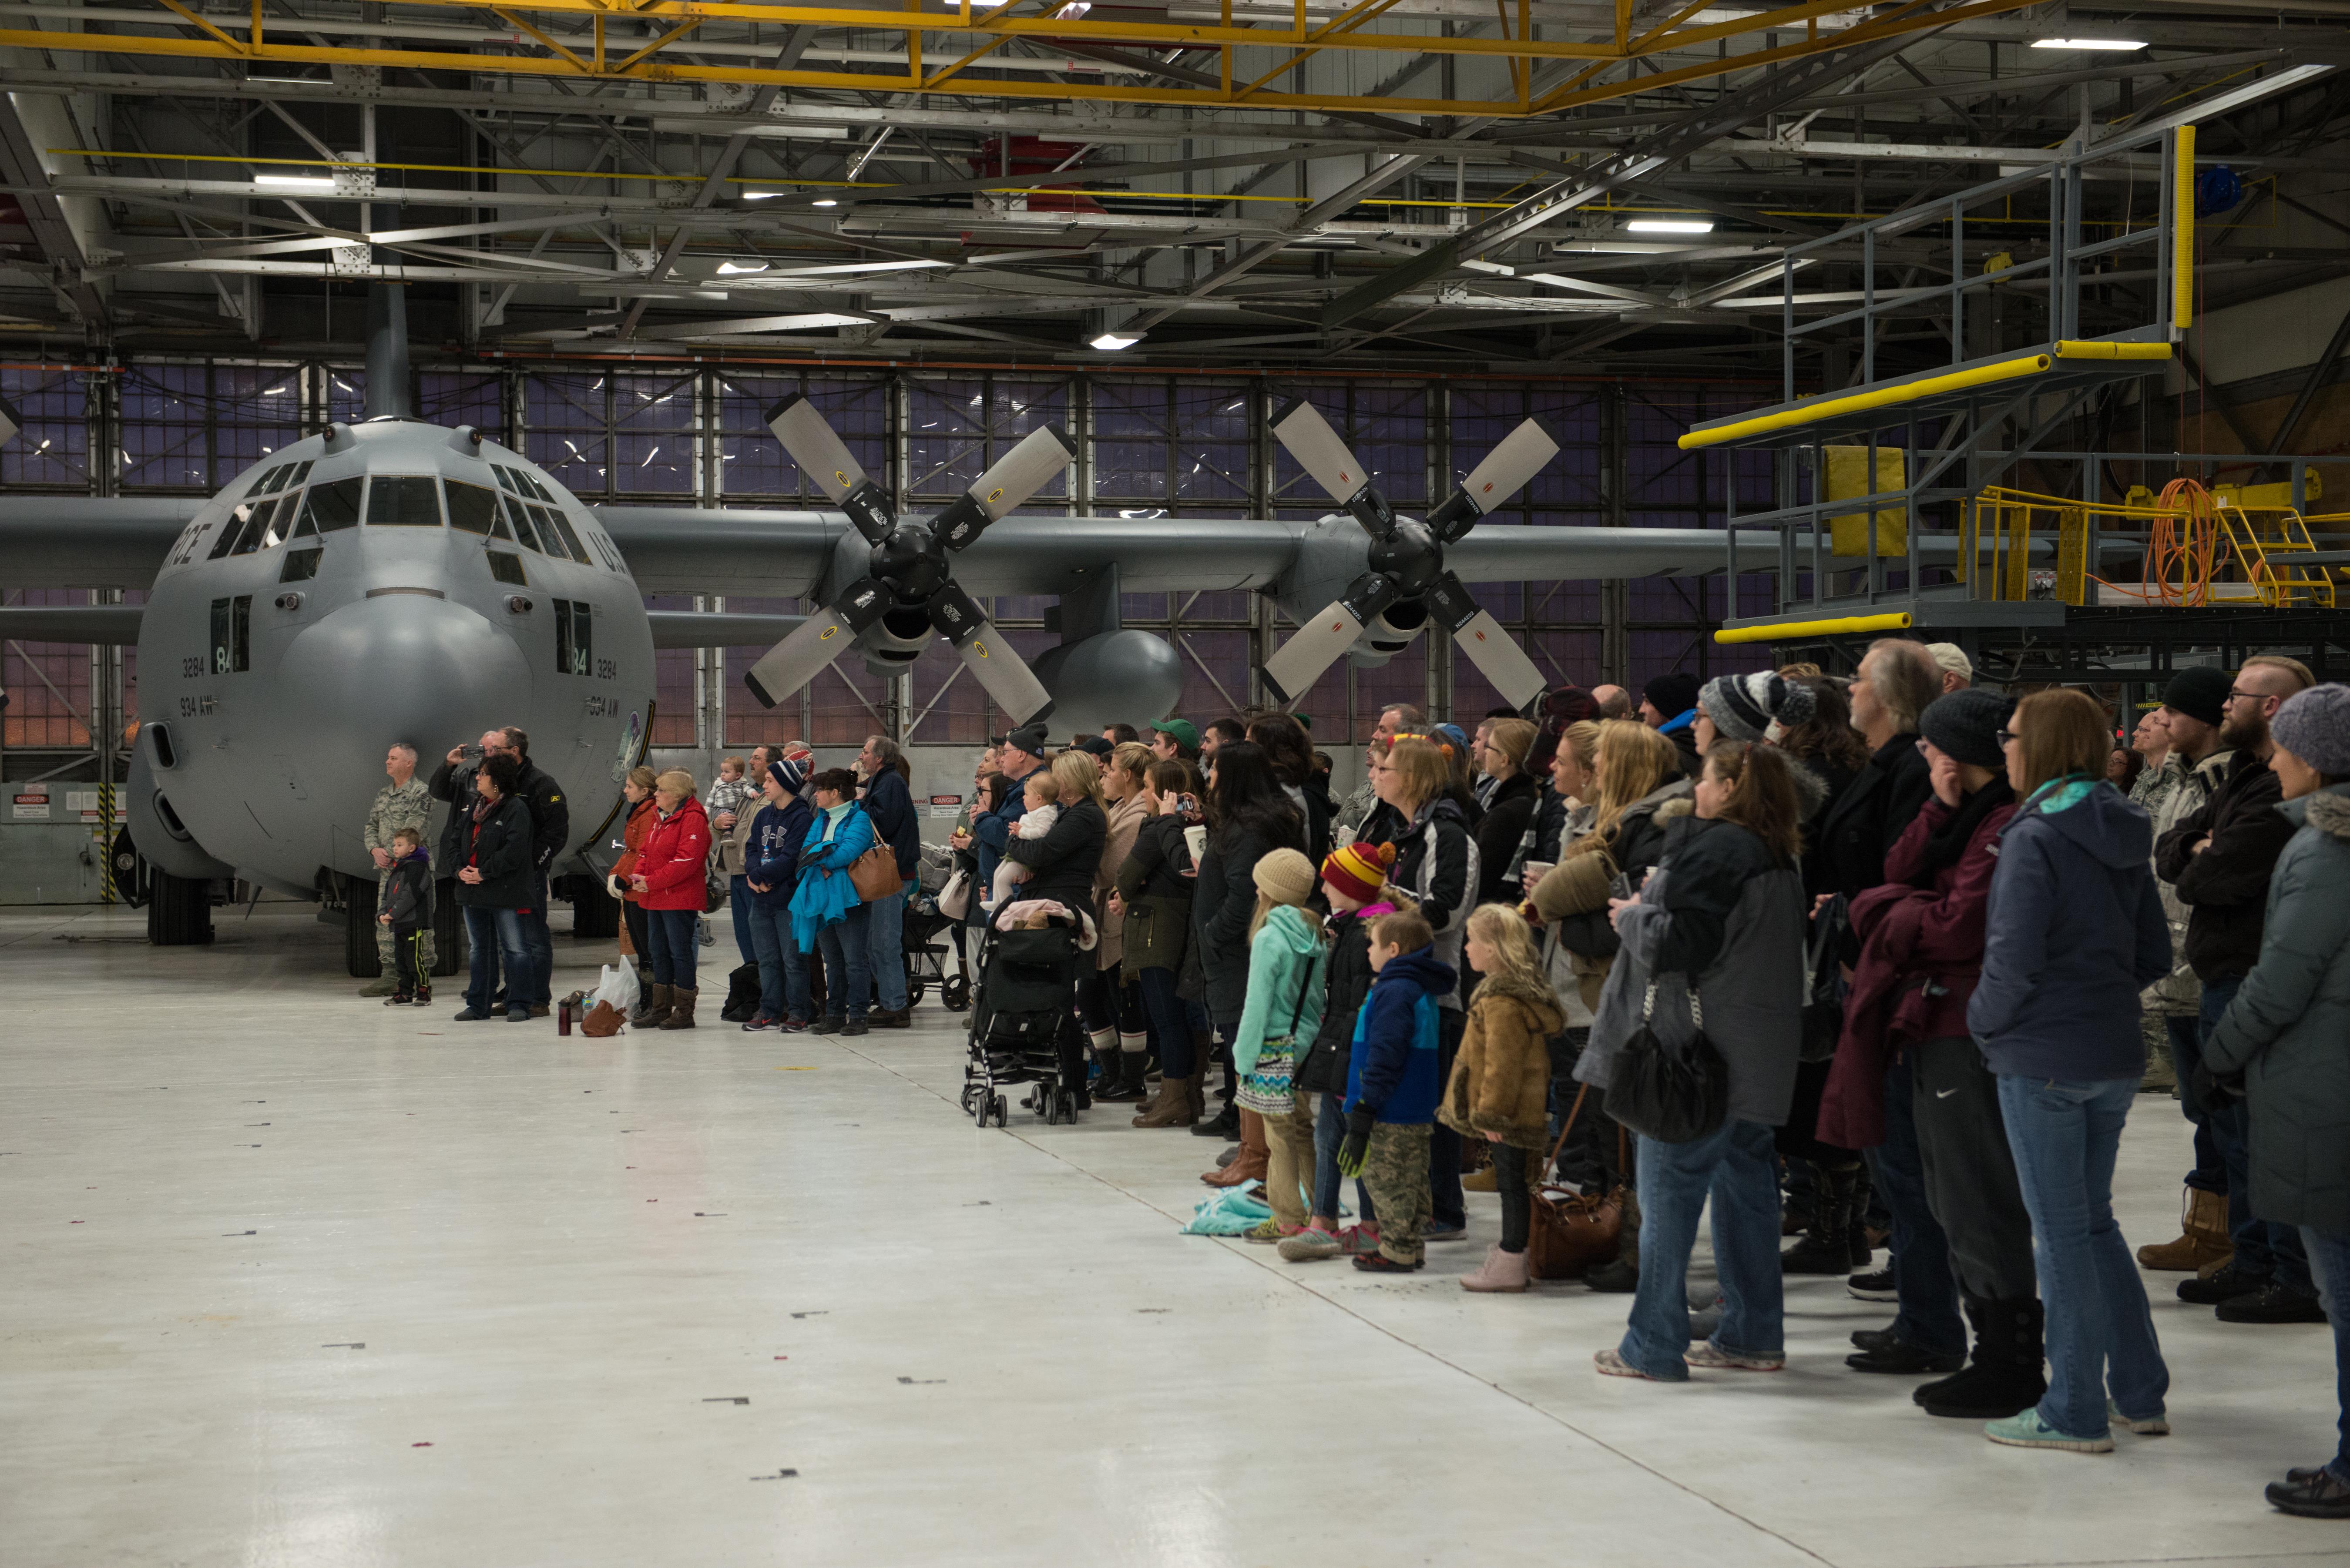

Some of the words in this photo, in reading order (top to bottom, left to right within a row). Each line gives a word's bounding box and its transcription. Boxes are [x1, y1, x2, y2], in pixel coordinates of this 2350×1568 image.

[1465, 495, 1480, 514] N244222
[1345, 602, 1362, 620] N244222
[1455, 611, 1475, 628] N244222
[183, 657, 204, 678] 3284
[598, 659, 616, 680] 3284
[181, 697, 196, 717] 934
[200, 695, 212, 716] AW
[590, 696, 606, 717] 934
[608, 698, 619, 718] AW
